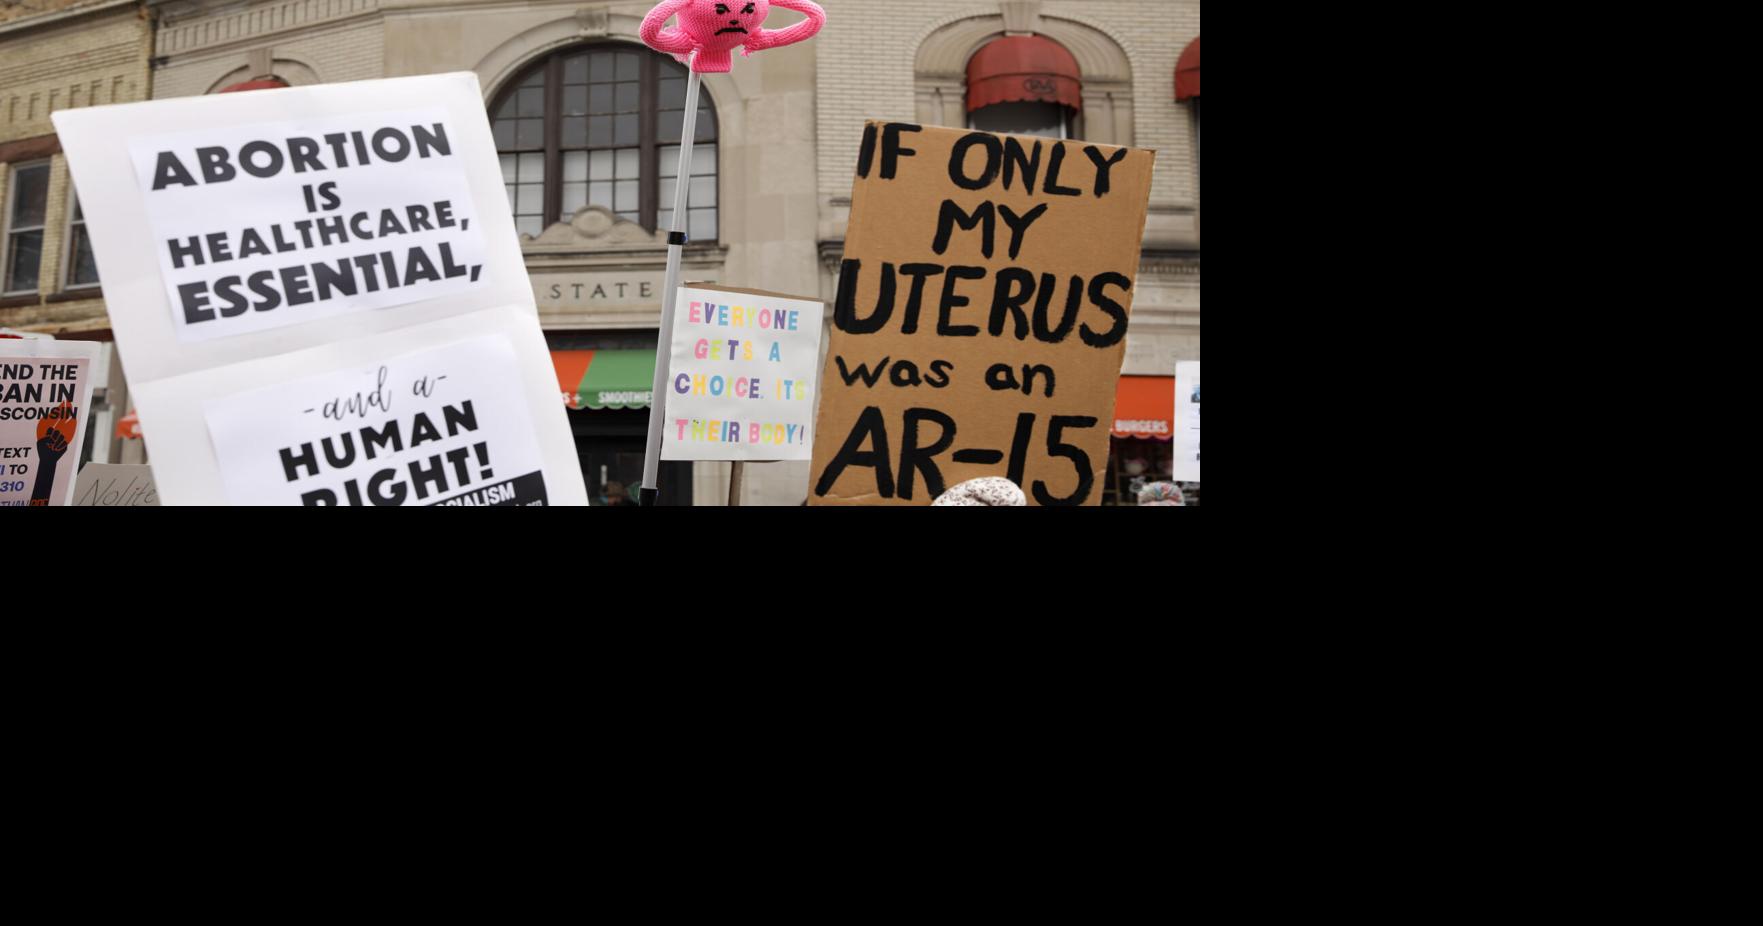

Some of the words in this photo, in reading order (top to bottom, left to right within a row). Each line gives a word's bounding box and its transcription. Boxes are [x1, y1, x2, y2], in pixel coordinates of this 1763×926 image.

[152, 122, 452, 191] ABORTION
[857, 122, 922, 180] IF
[948, 131, 1128, 198] ONLY
[302, 181, 341, 213] IS
[167, 200, 470, 269] HEALTHCARE,
[931, 199, 1048, 261] MY
[177, 241, 483, 325] ESSENTIAL,
[550, 282, 653, 300] STATE
[688, 301, 799, 331] EVERYONE
[834, 258, 1132, 349] UTERUS
[694, 338, 753, 361] GETS
[768, 341, 781, 362] A
[0, 364, 34, 381] ND
[39, 364, 79, 381] THE
[835, 355, 954, 389] was
[984, 362, 1056, 398] an
[49, 383, 76, 403] IN
[776, 379, 806, 401] ITS
[278, 399, 479, 482] HUMAN
[675, 418, 741, 443] THEIR
[749, 421, 805, 446] BODY!
[9, 463, 29, 476] TO
[815, 405, 1098, 506] AR-15
[437, 481, 516, 506] IALISM
